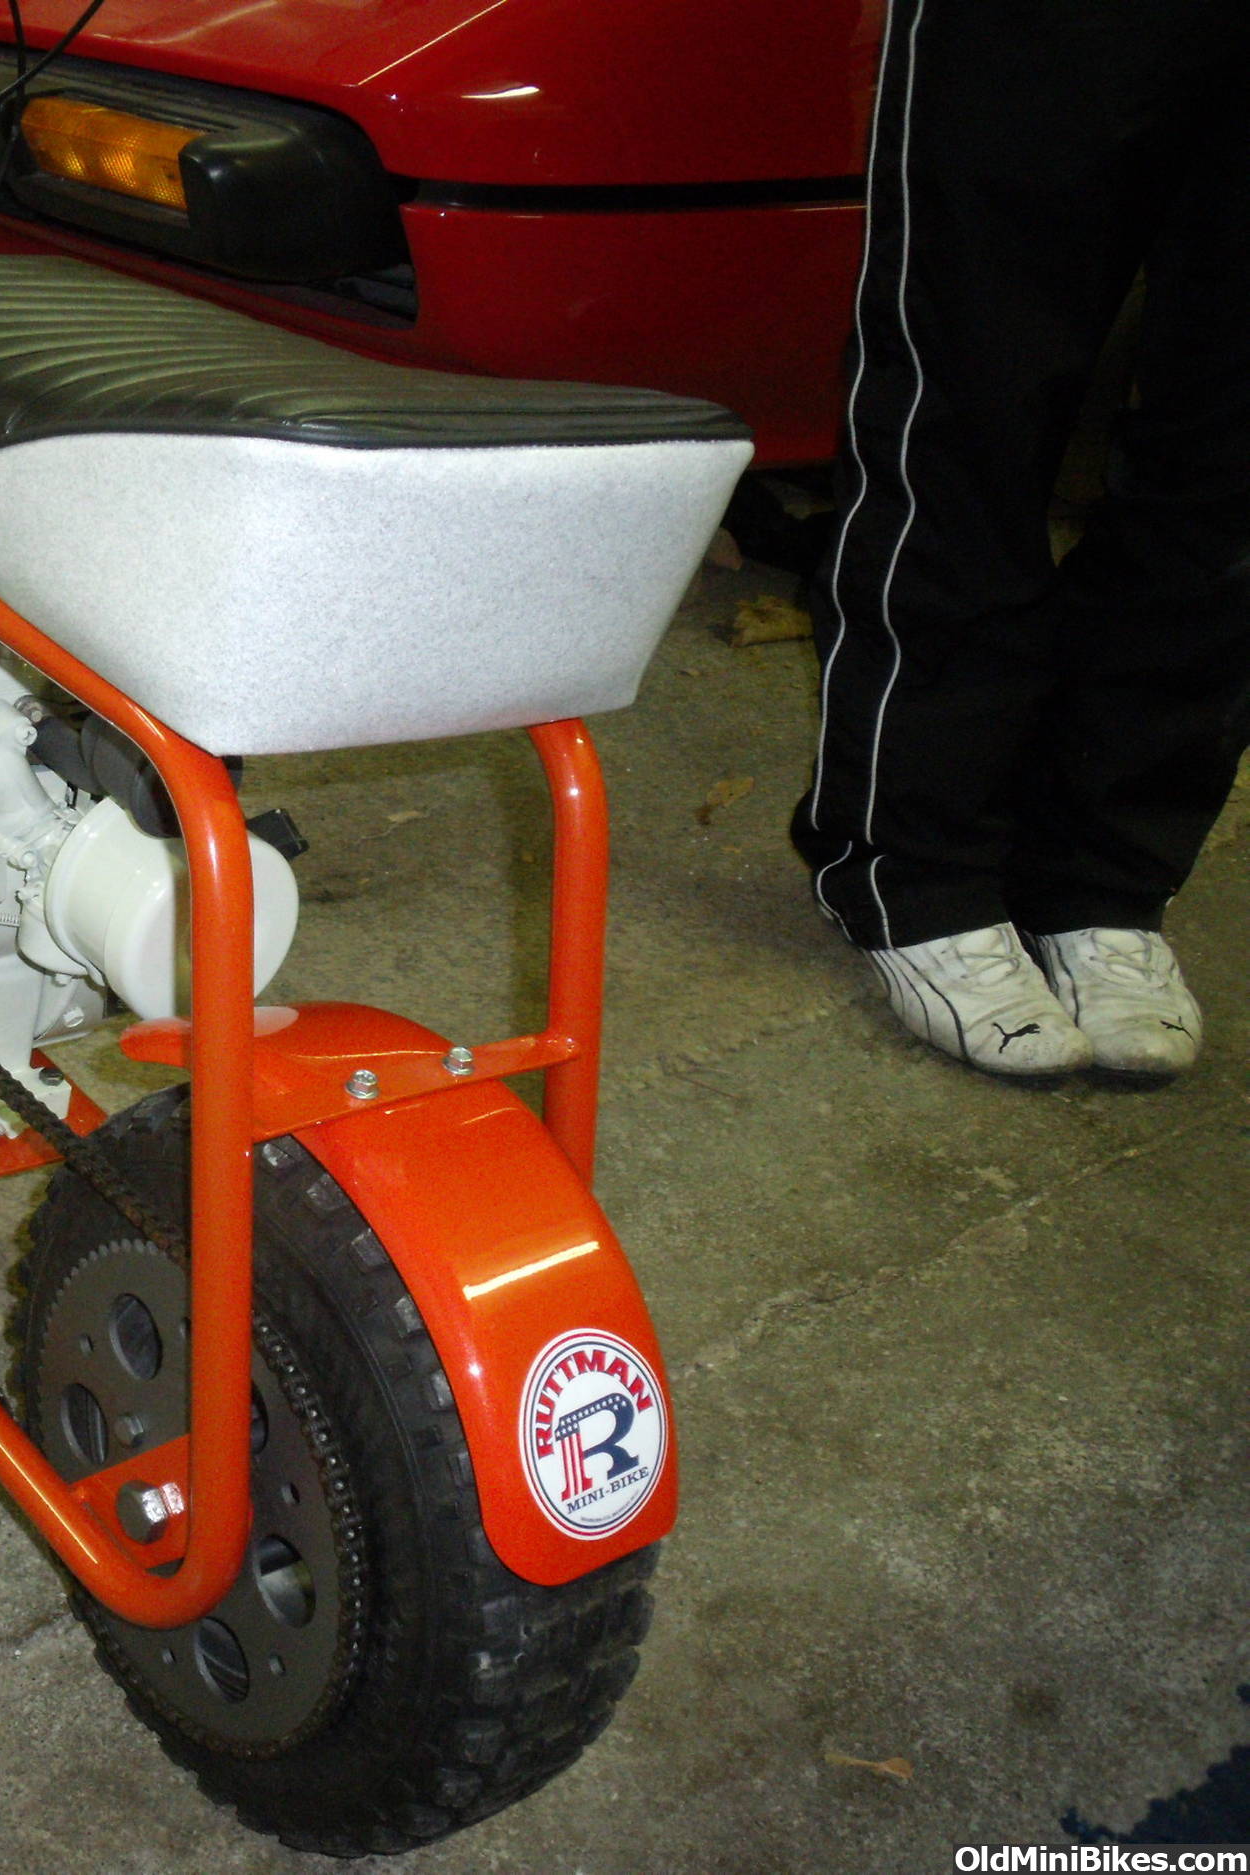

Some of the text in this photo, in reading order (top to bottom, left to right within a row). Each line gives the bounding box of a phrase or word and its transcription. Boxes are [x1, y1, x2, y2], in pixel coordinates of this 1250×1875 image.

[535, 1349, 654, 1459] RUTTMAN
[554, 1393, 639, 1501] R
[566, 1466, 649, 1515] MINI-BIKE
